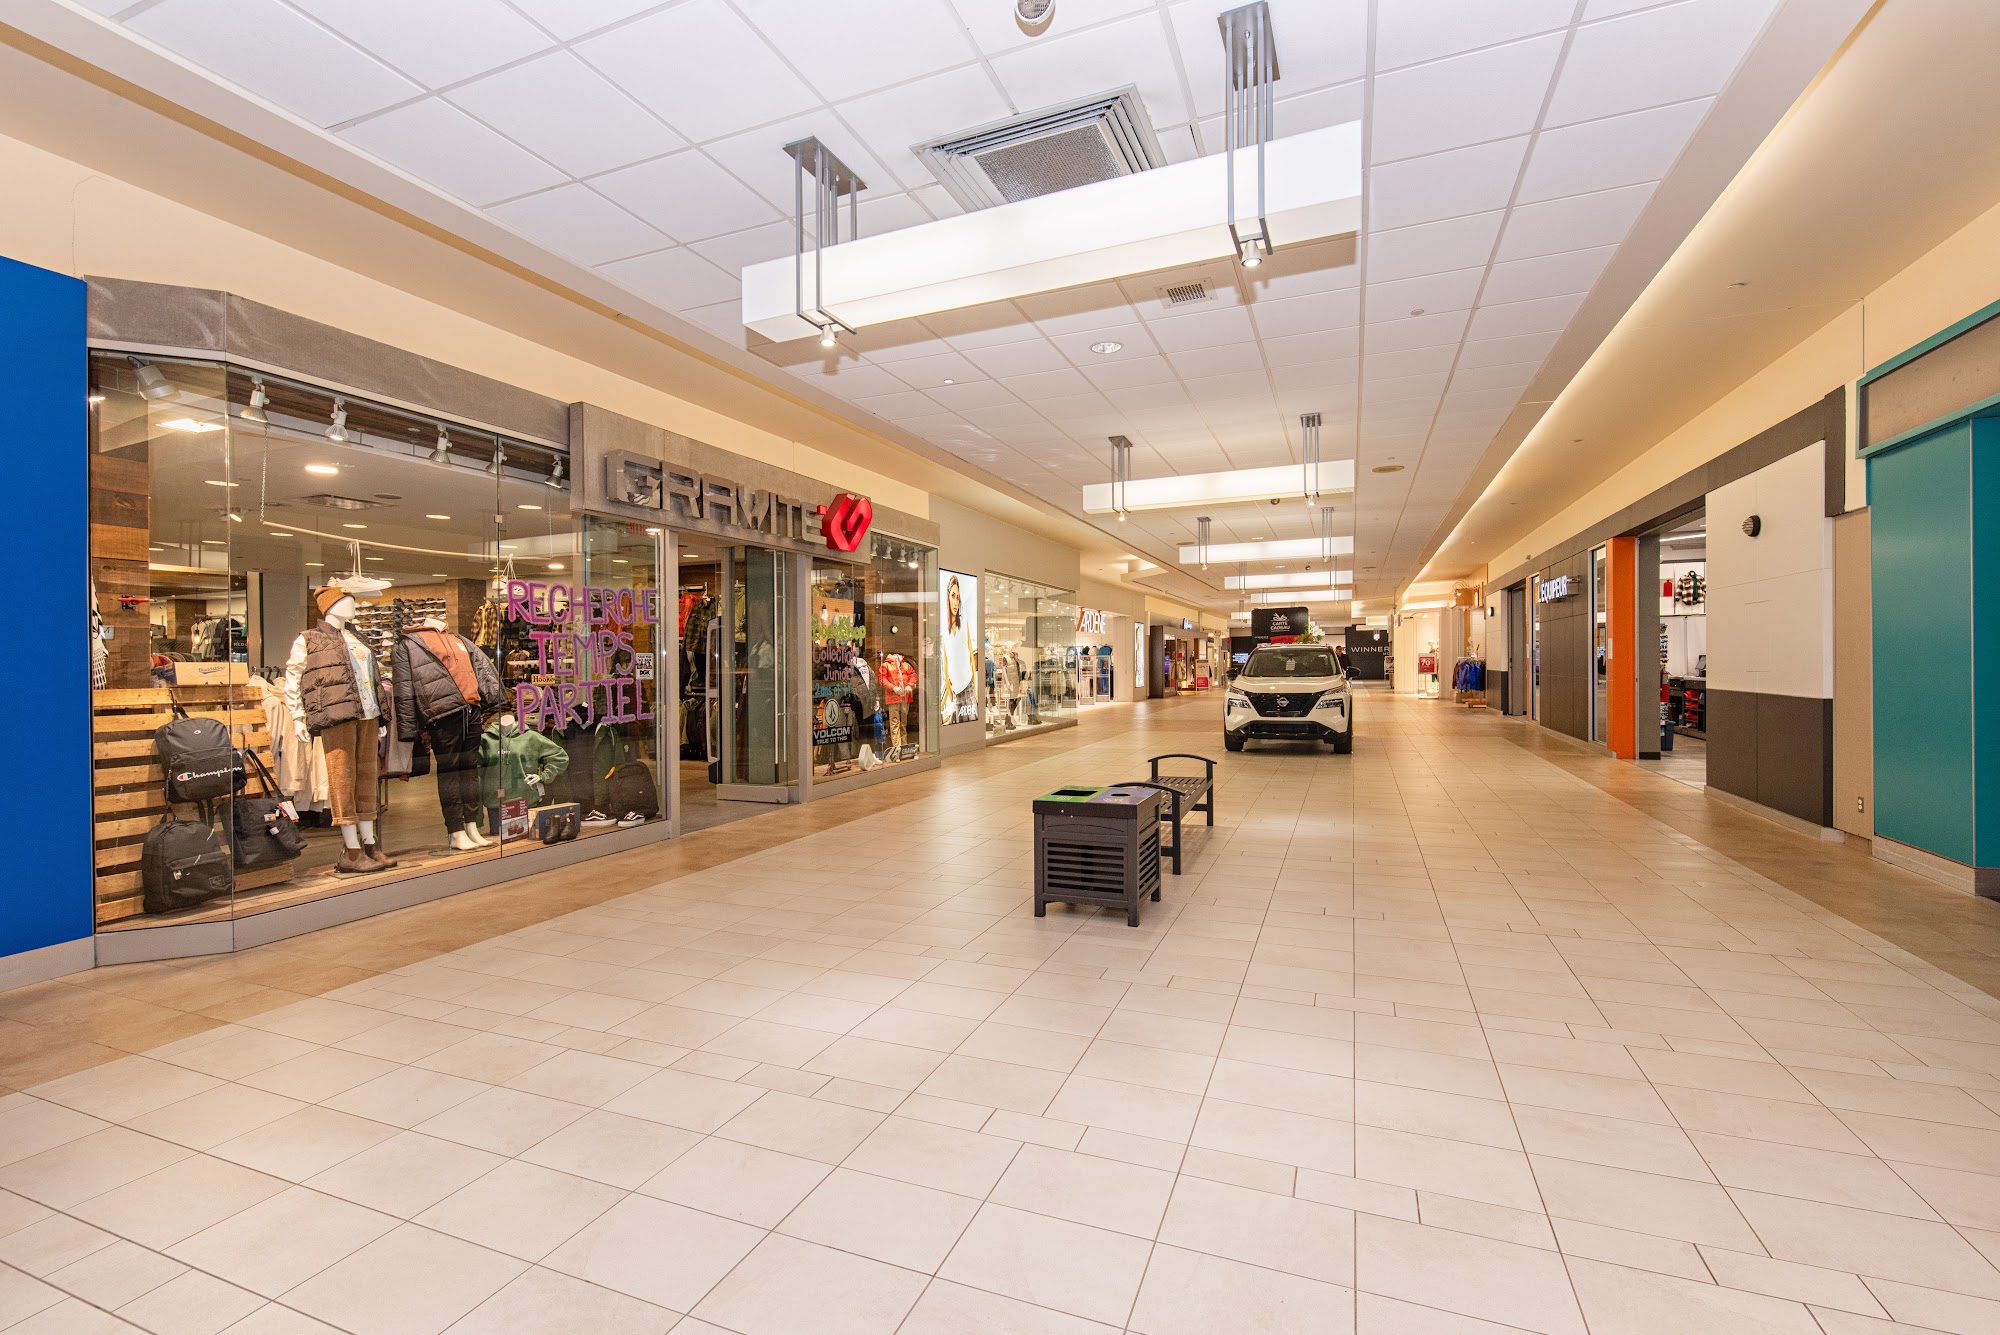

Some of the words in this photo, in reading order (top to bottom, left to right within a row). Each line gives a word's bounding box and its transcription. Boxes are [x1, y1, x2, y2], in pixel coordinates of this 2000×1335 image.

[507, 579, 659, 625] RECHERCHE
[1079, 610, 1106, 634] ARDENE
[528, 629, 637, 677] TEMPS
[812, 645, 858, 666] Collection
[516, 678, 654, 734] PARTIEL
[814, 726, 851, 739] VOLCOM
[177, 765, 243, 782] Champion
